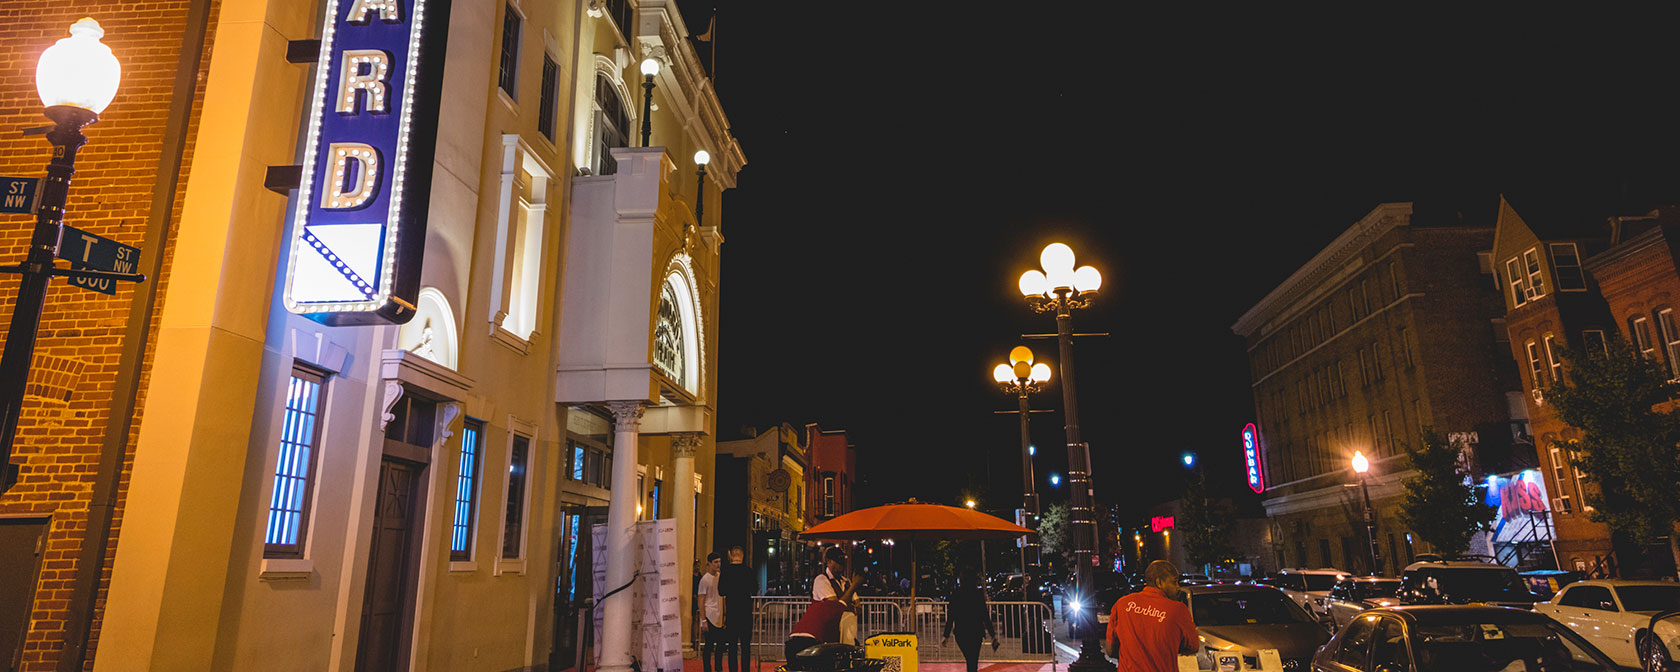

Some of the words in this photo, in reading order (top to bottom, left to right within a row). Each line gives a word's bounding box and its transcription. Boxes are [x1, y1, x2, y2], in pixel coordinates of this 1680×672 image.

[9, 181, 28, 194] ST
[4, 195, 26, 208] NW
[81, 234, 99, 263] T
[116, 246, 133, 261] ST
[113, 259, 133, 274] NW
[1244, 432, 1258, 484] DUNBAR
[1125, 601, 1167, 623] Parking
[881, 638, 912, 647] ValPark
